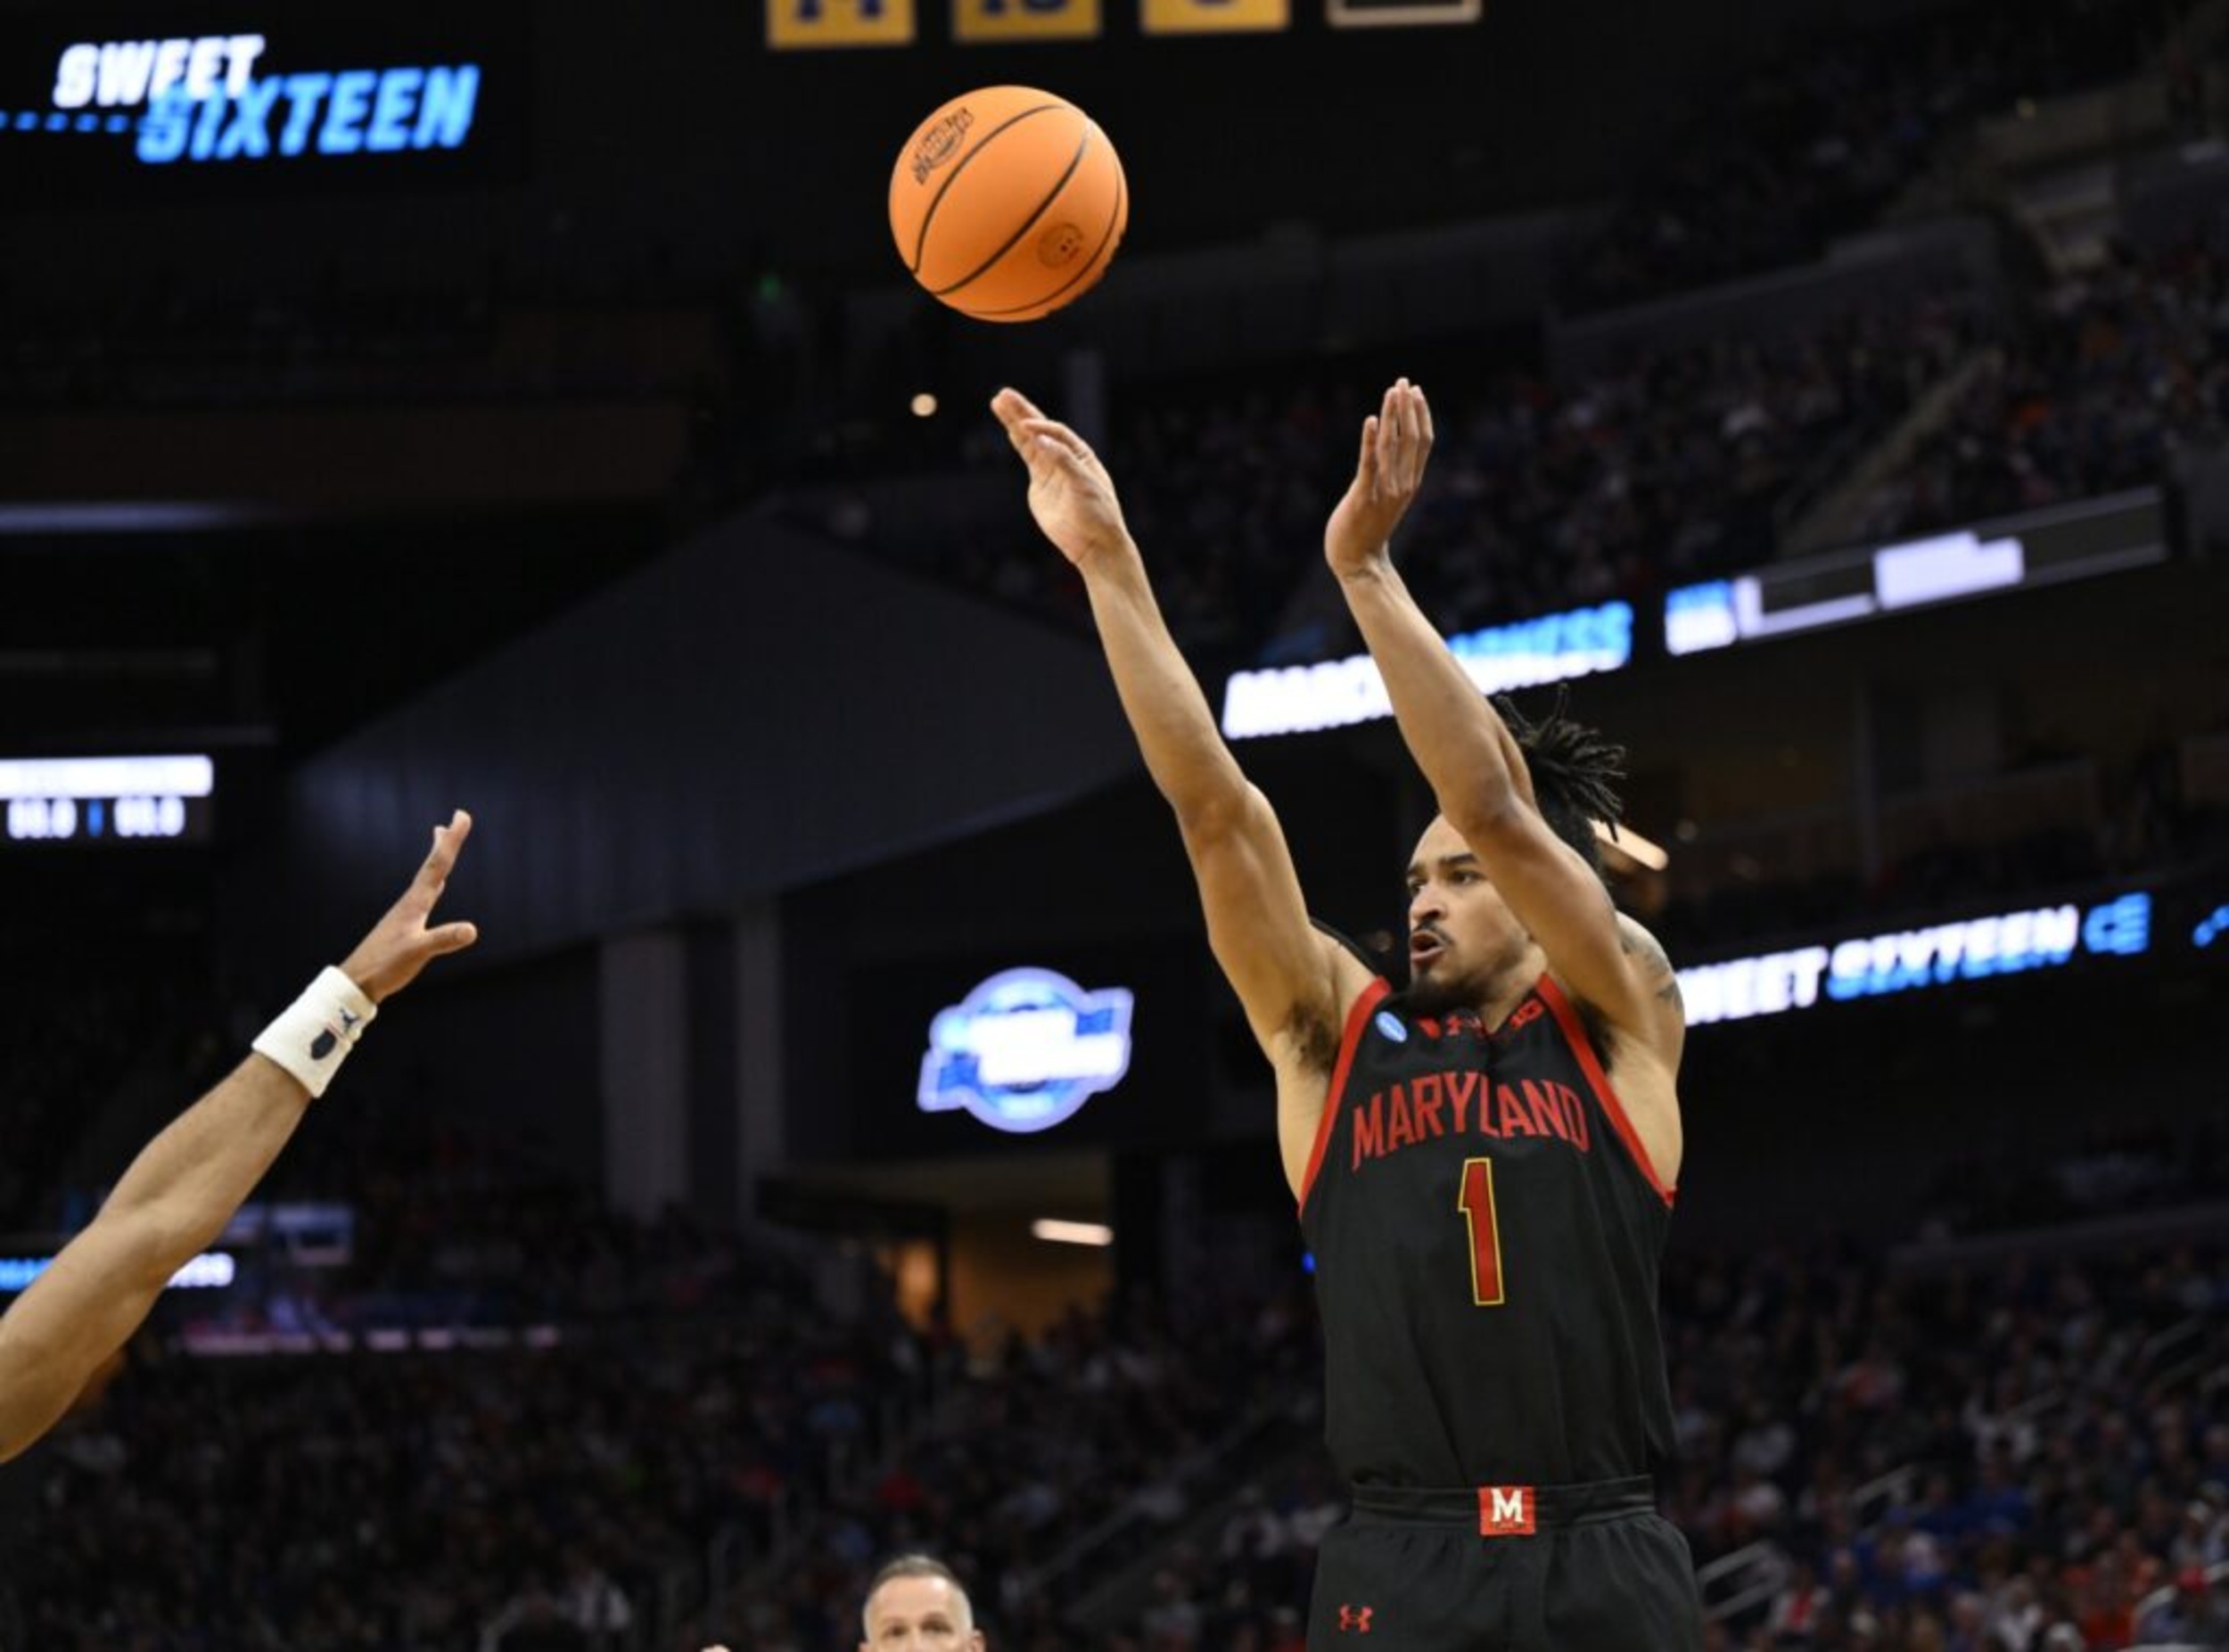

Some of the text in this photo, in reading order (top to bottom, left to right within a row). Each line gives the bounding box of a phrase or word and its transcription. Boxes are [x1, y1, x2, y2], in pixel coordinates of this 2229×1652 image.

[53, 34, 266, 108] SWEET
[135, 64, 481, 163] SIXTEEN
[1352, 1072, 1590, 1173] MARYLAND
[1458, 1156, 1505, 1306] 1
[1490, 1486, 1524, 1523] M
